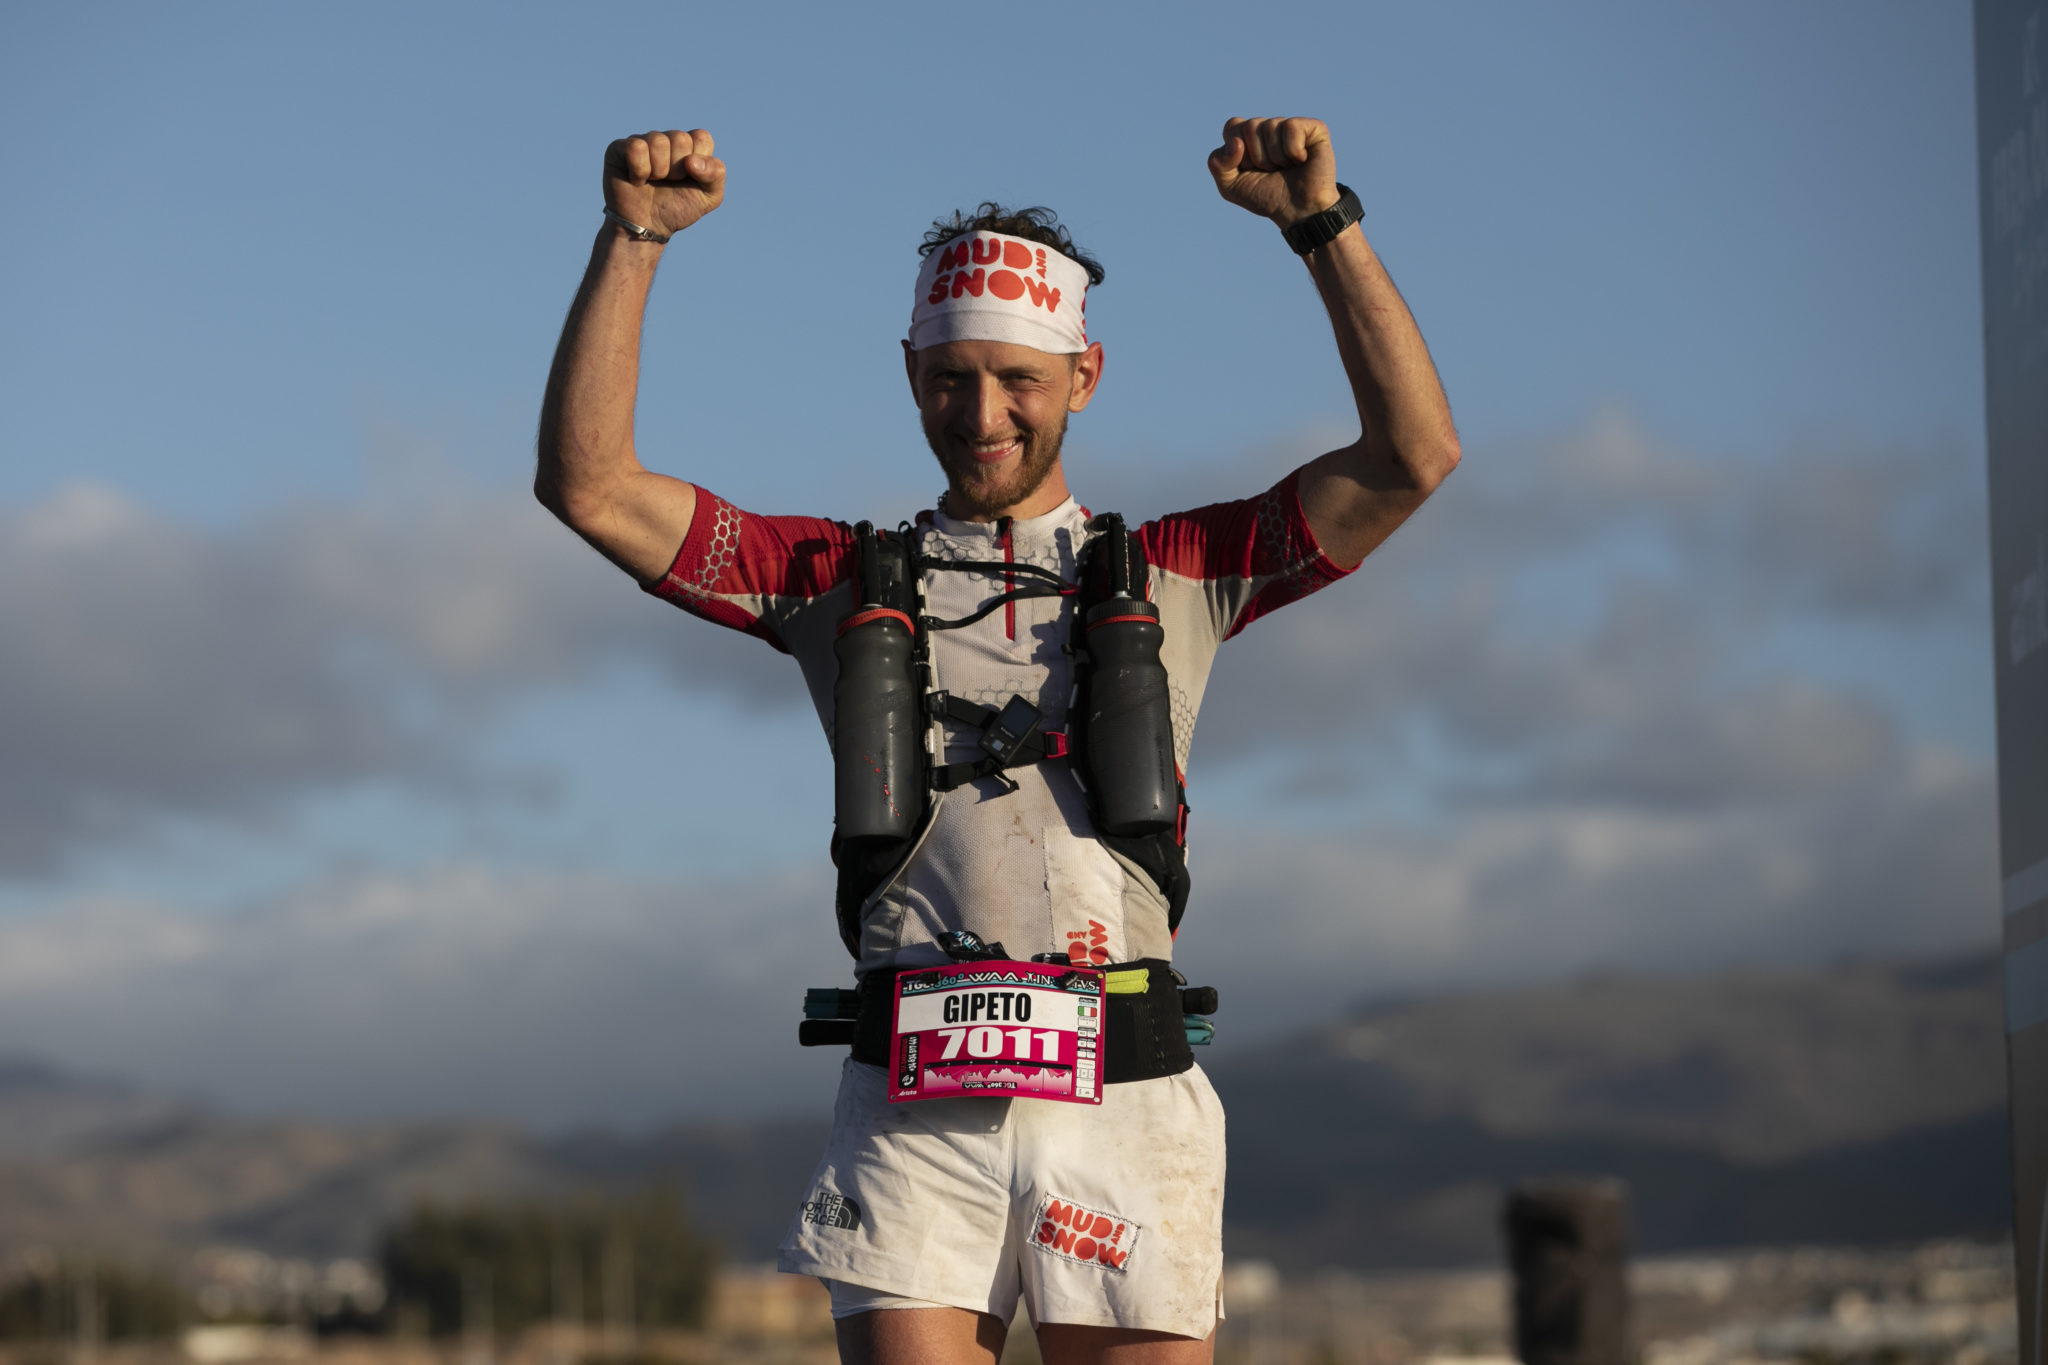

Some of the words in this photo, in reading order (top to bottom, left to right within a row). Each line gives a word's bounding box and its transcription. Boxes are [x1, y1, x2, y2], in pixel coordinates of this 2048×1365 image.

[936, 238, 1033, 275] MUD
[1035, 248, 1047, 279] AND
[928, 268, 1062, 313] SNOW
[943, 991, 1032, 1024] GIPETO
[937, 1027, 1060, 1062] 7011
[799, 1201, 839, 1215] NORTH
[820, 1192, 843, 1205] THE
[804, 1212, 836, 1226] FACE
[1045, 1199, 1113, 1239] MUD
[1113, 1223, 1126, 1245] AND
[1037, 1222, 1128, 1269] SNOW
